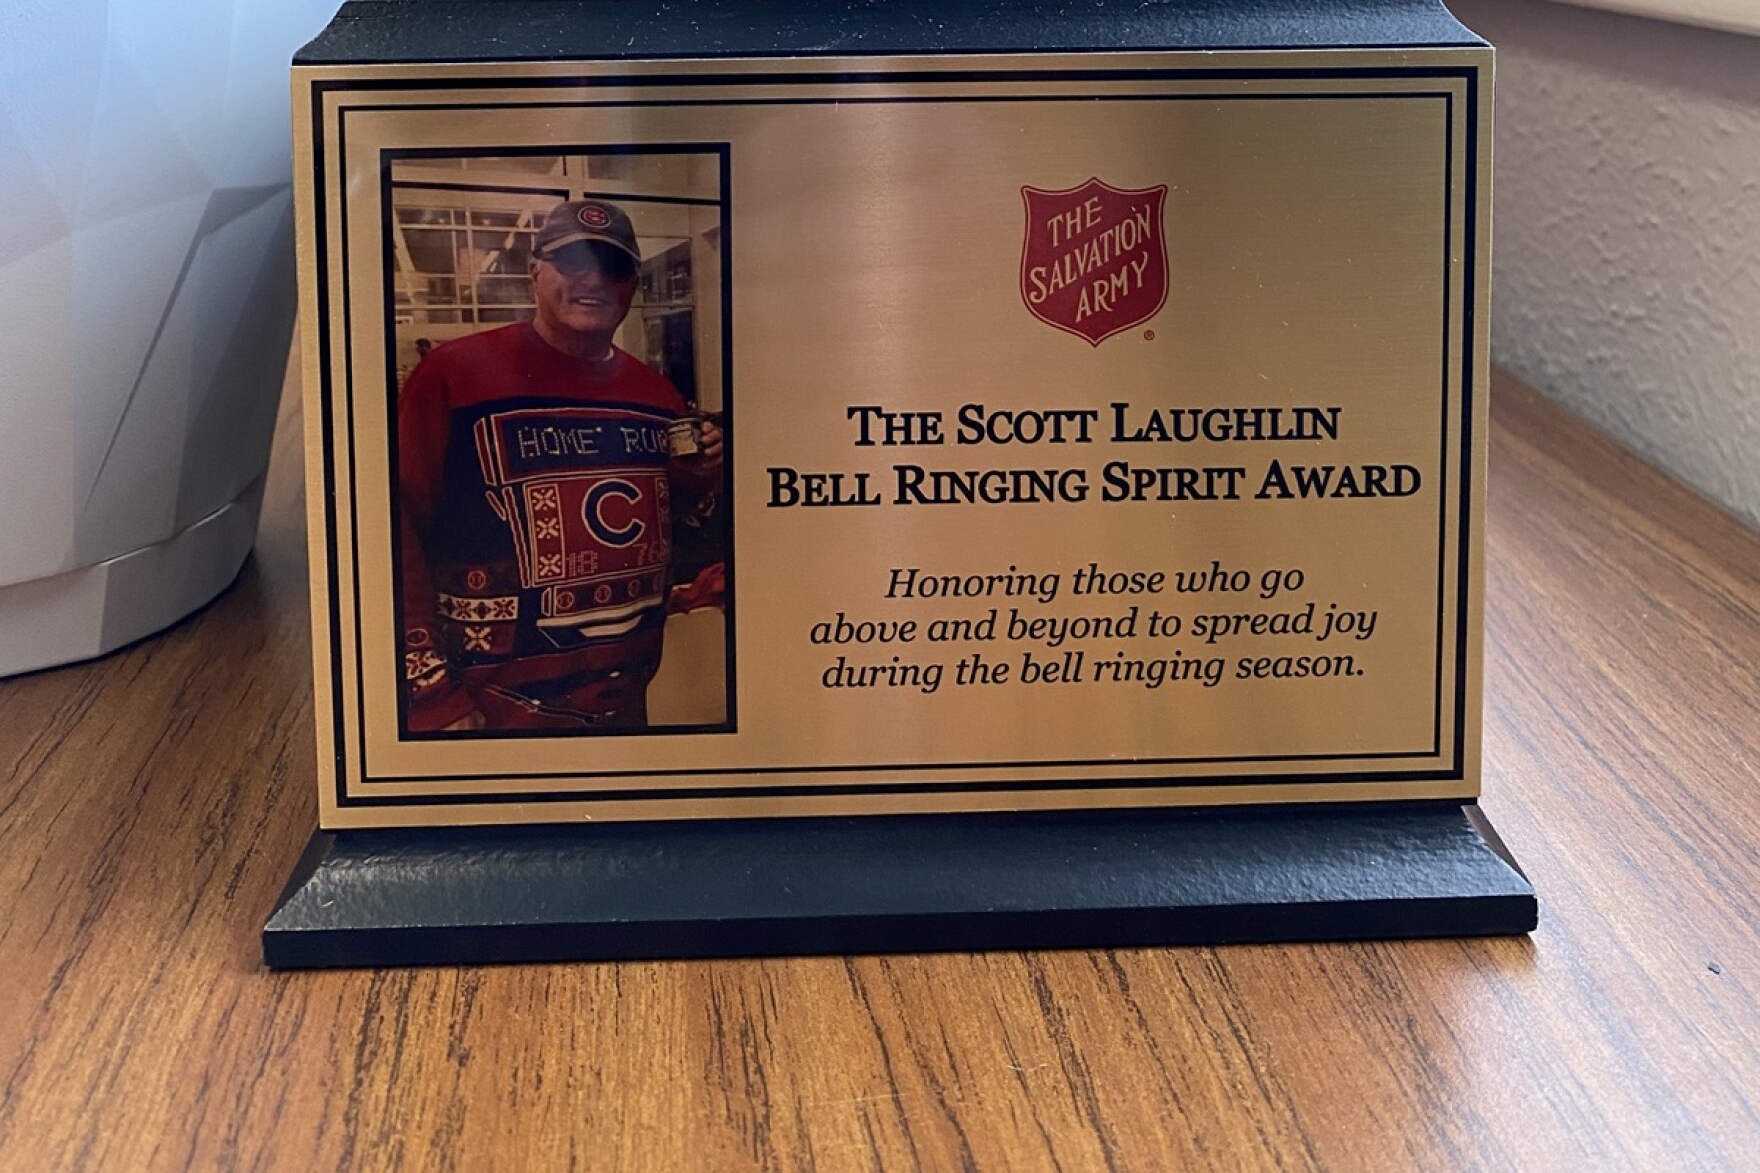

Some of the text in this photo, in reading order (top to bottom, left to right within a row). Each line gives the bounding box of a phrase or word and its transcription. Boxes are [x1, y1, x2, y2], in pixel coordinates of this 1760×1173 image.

[1047, 196, 1102, 248] THE
[1029, 204, 1151, 303] SALVATION
[1075, 251, 1148, 323] ARMY
[847, 403, 1342, 446] THE SCOTT LAUGHLIN
[767, 459, 1421, 507] BELL RINGING SPIRIT AWARD
[581, 478, 645, 548] C
[884, 561, 1304, 603] Honoring those who go
[811, 603, 1377, 647] above and beyond to spread joy
[823, 650, 1363, 693] during the bell ringing season.
